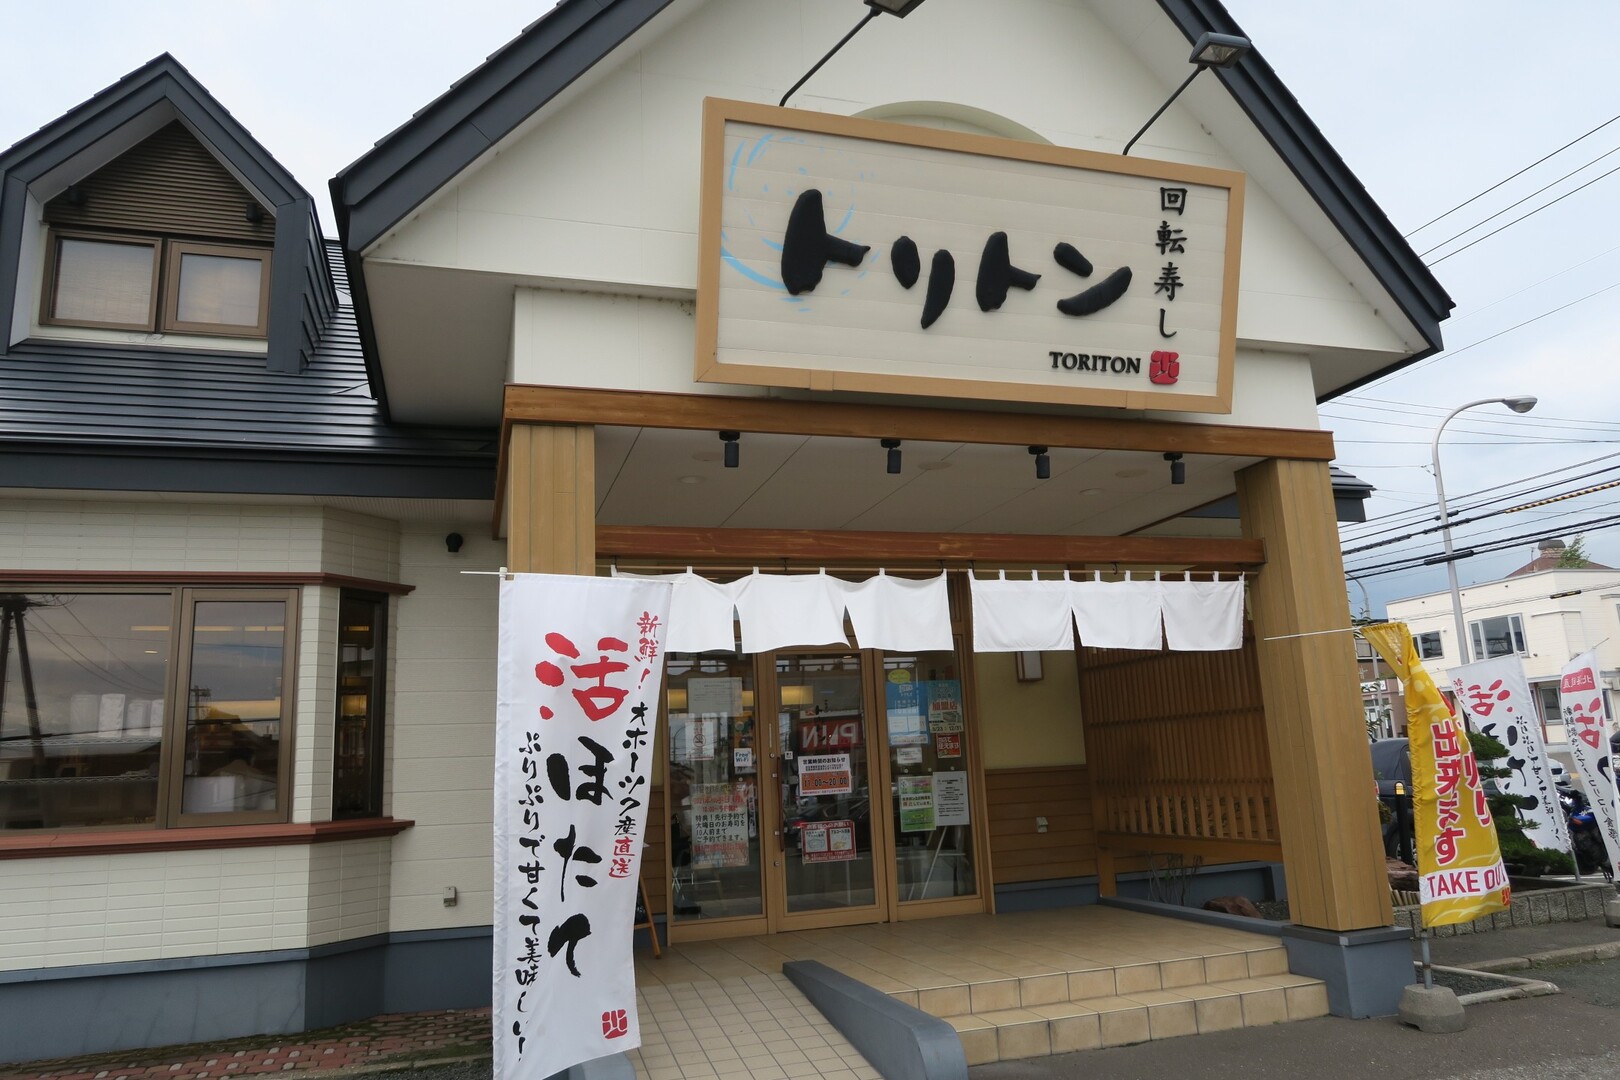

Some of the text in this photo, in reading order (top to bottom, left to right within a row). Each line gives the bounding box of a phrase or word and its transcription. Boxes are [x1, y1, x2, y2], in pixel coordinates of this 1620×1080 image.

[780, 188, 1133, 329] トリトン
[1154, 187, 1188, 338] 回転寿し
[1049, 351, 1142, 375] TORITON
[803, 757, 846, 765] 営業時間のお知らせ
[534, 632, 630, 978] 活ほたて
[1427, 870, 1481, 898] TAKE
